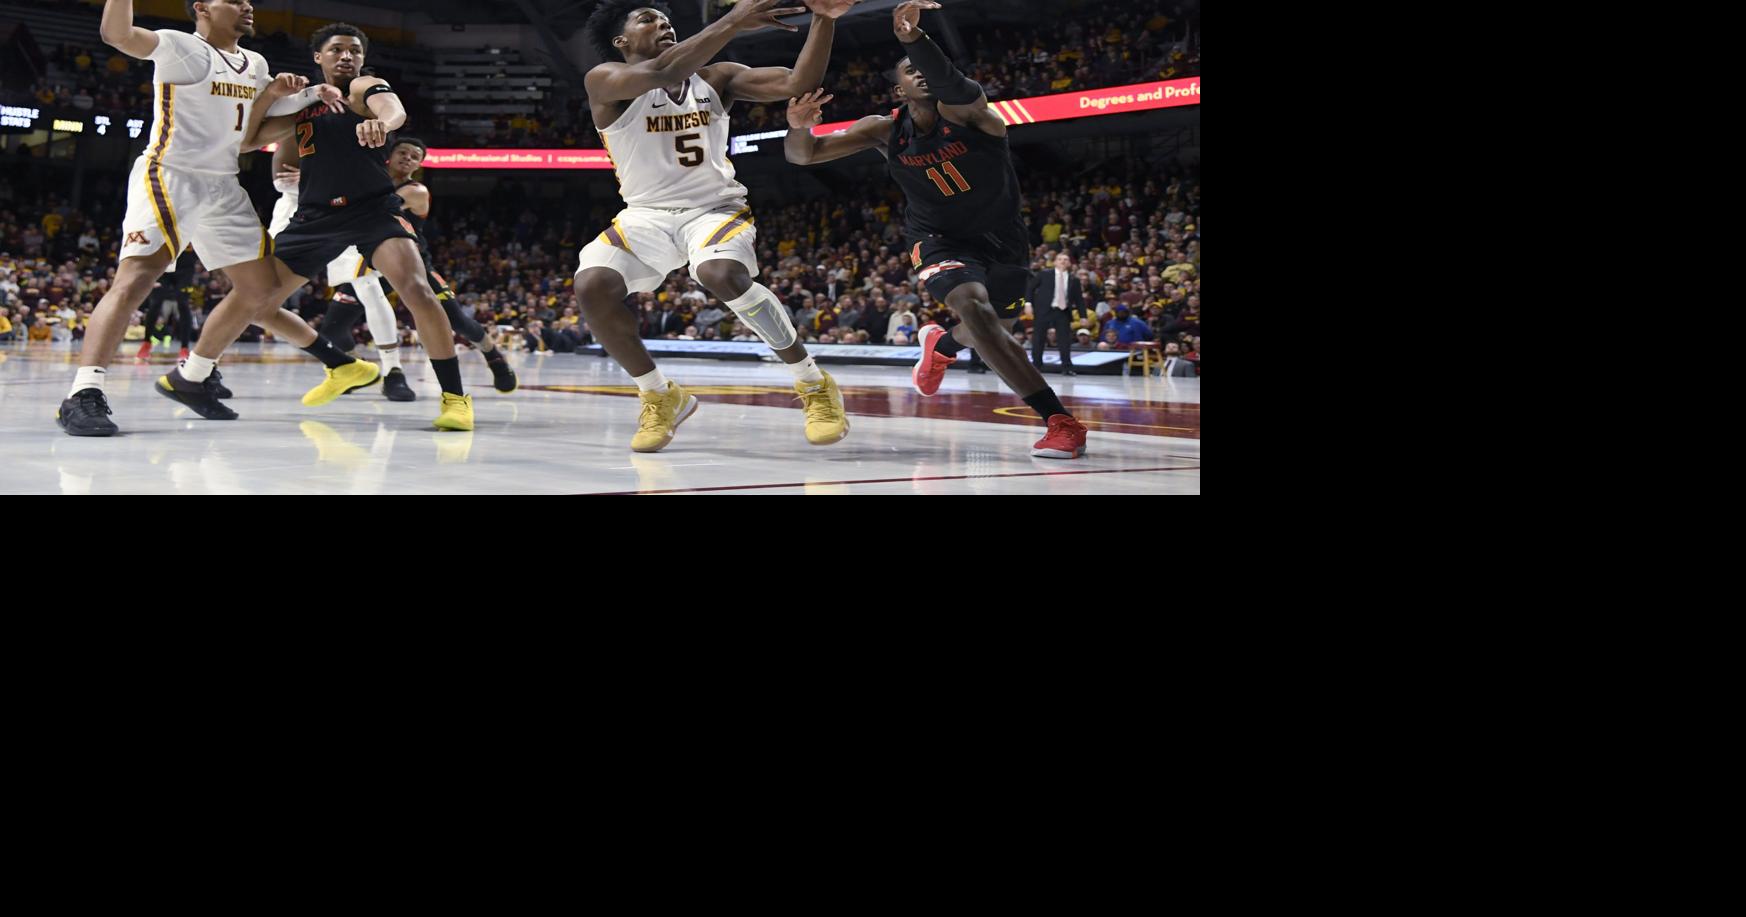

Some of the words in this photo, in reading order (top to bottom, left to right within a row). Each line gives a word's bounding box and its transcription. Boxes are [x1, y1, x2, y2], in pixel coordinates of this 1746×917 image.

[1080, 94, 1134, 109] Degrees
[1137, 87, 1162, 102] and
[234, 103, 244, 131] 1
[646, 110, 710, 133] MINNESO
[297, 122, 316, 158] 2
[675, 133, 704, 168] 5
[440, 153, 457, 162] and
[457, 153, 510, 162] Professional
[511, 153, 543, 163] Studies
[898, 141, 969, 167] MARYLAND
[926, 161, 971, 197] 11
